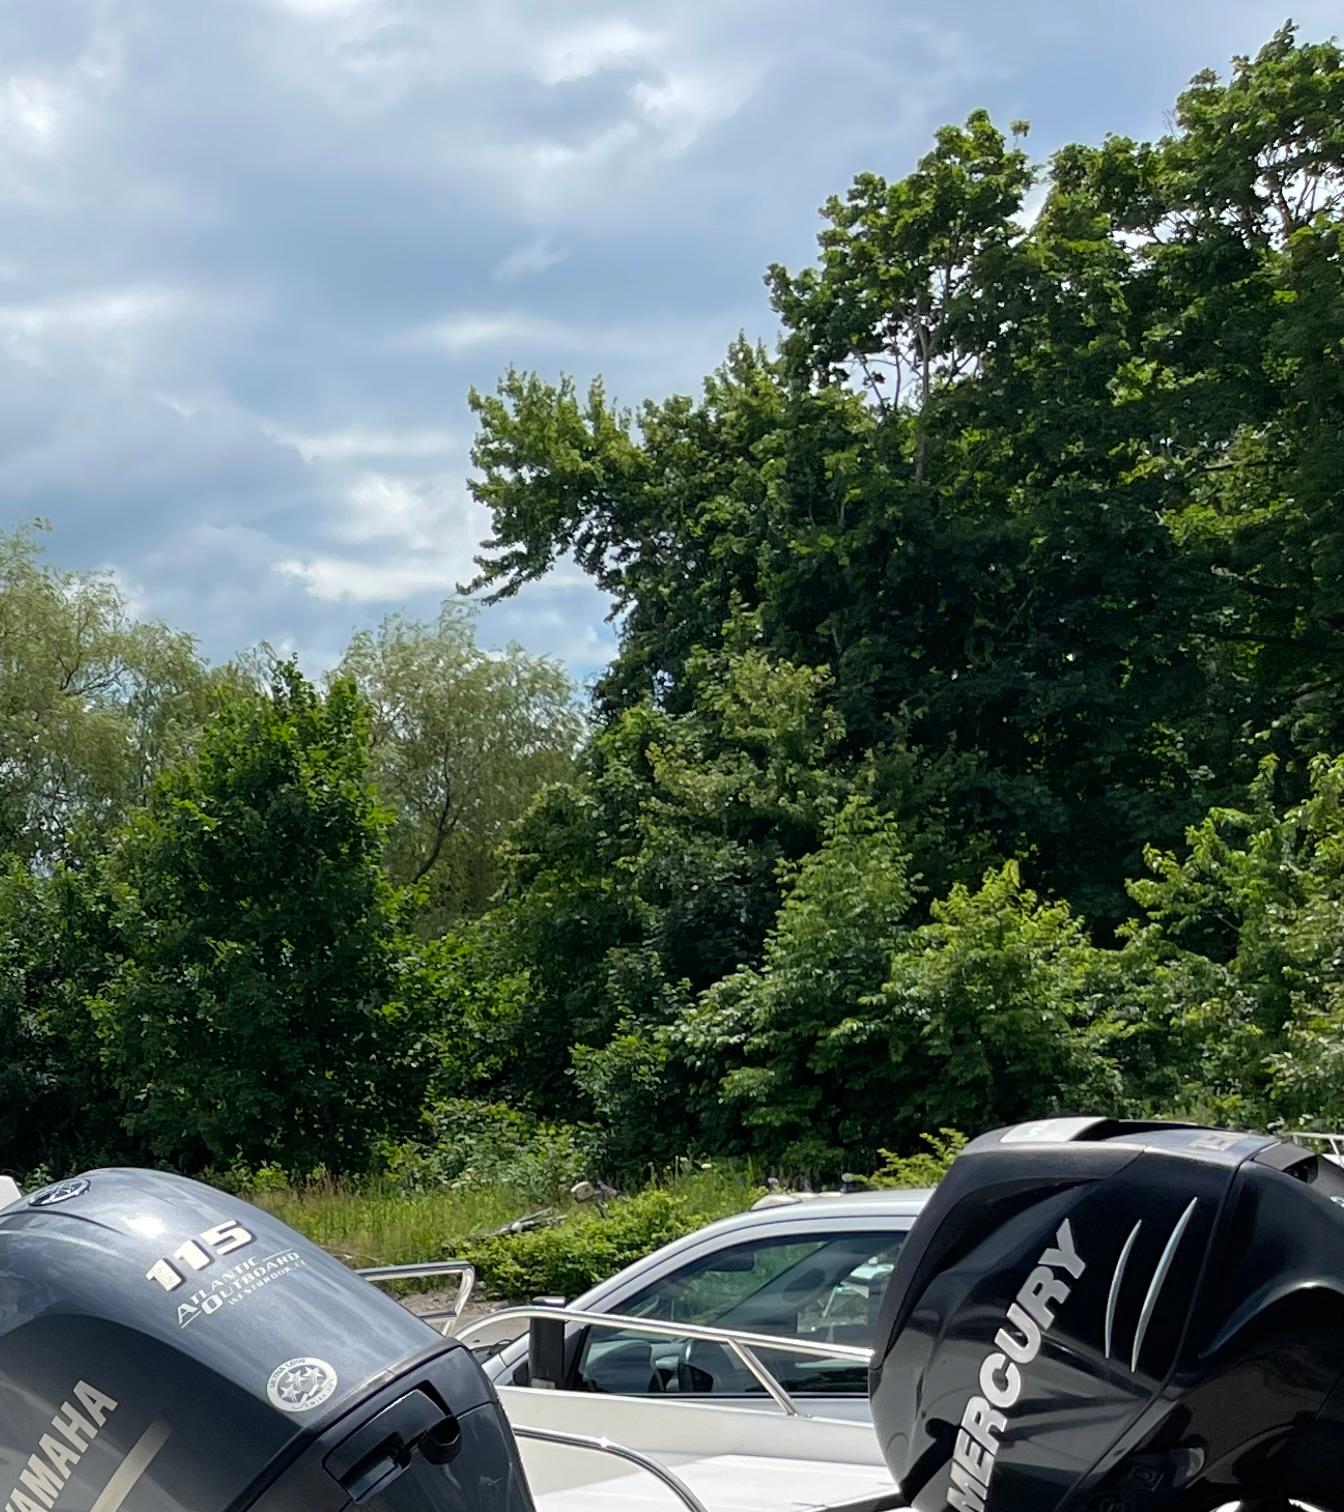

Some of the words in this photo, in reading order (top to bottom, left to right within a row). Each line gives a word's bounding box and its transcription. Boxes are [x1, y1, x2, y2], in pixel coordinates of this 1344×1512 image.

[145, 1219, 256, 1292] 115
[176, 1255, 258, 1326] ATLANTIC
[201, 1252, 300, 1316] OUTBOARD
